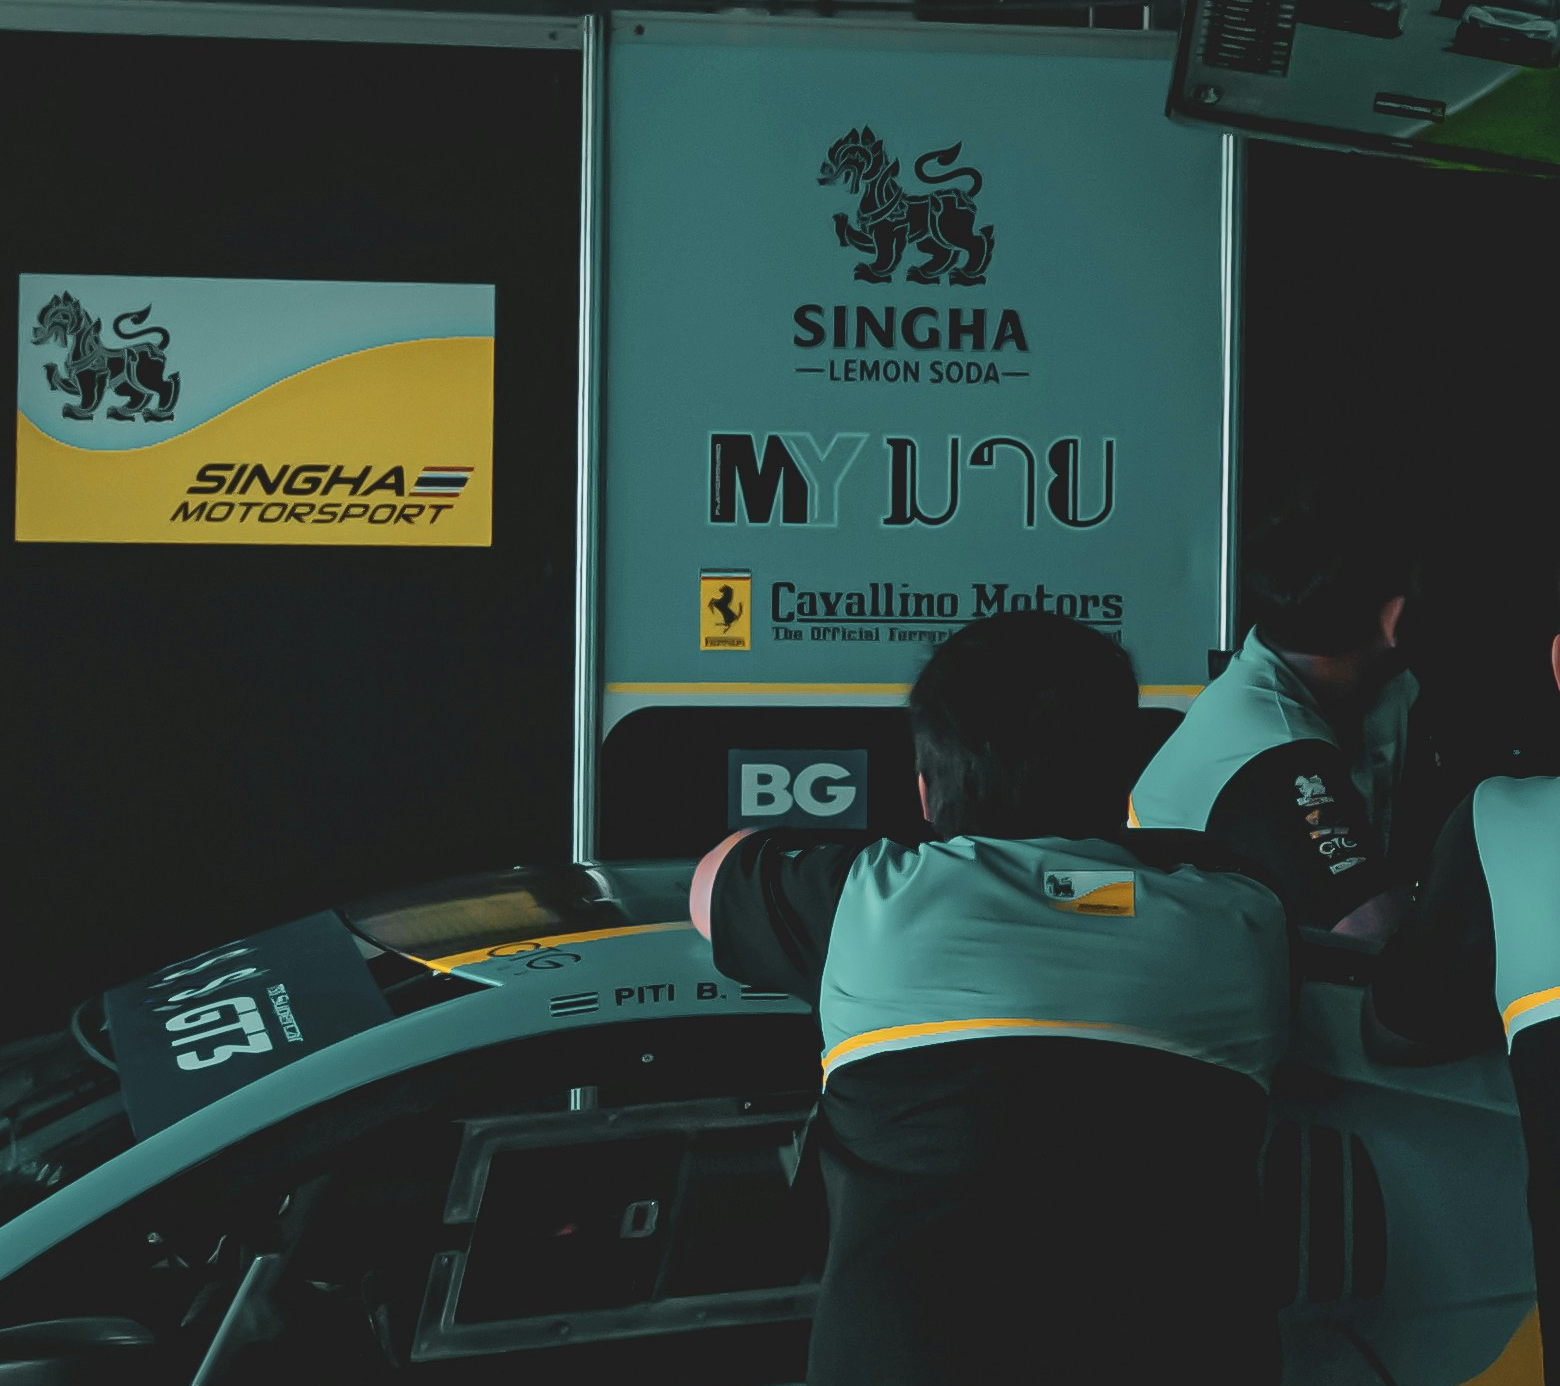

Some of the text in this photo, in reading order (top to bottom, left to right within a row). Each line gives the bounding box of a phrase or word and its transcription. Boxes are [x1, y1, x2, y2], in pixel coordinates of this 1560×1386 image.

[792, 305, 1029, 351] SINGHA
[829, 360, 1000, 384] LEMON SODA
[187, 464, 406, 496] SINGHA
[708, 431, 870, 527] MY
[170, 501, 454, 525] MOTORSPORT
[772, 581, 1124, 622] Cavallino Motors
[811, 625, 880, 642] Official
[741, 762, 856, 816] BG
[614, 981, 727, 1006] PITI B.
[164, 996, 273, 1071] GT3
